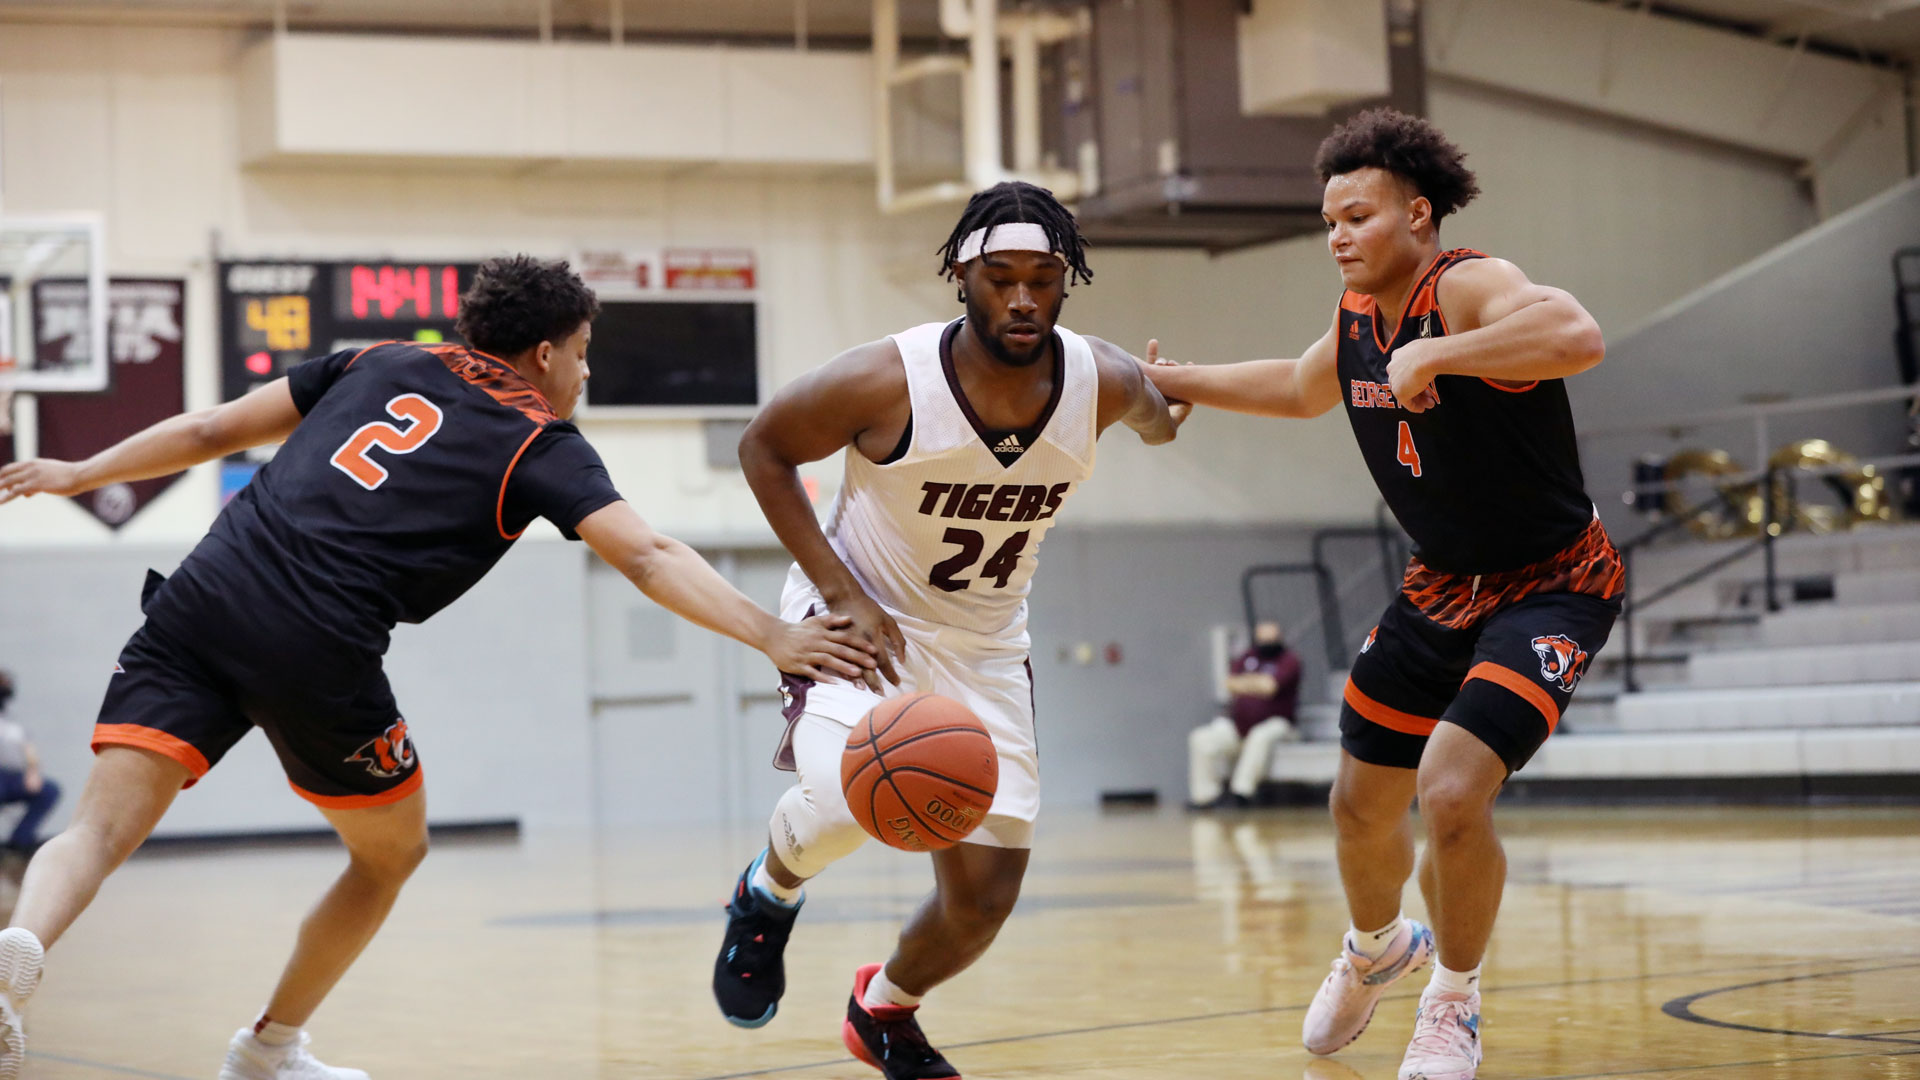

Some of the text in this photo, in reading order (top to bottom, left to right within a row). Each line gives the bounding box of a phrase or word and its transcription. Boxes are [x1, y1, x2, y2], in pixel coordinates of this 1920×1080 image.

[330, 393, 443, 490] 2
[993, 444, 1024, 453] adidas
[1397, 420, 1422, 477] 4
[918, 481, 1070, 522] TIGERS
[929, 527, 1031, 592] 24
